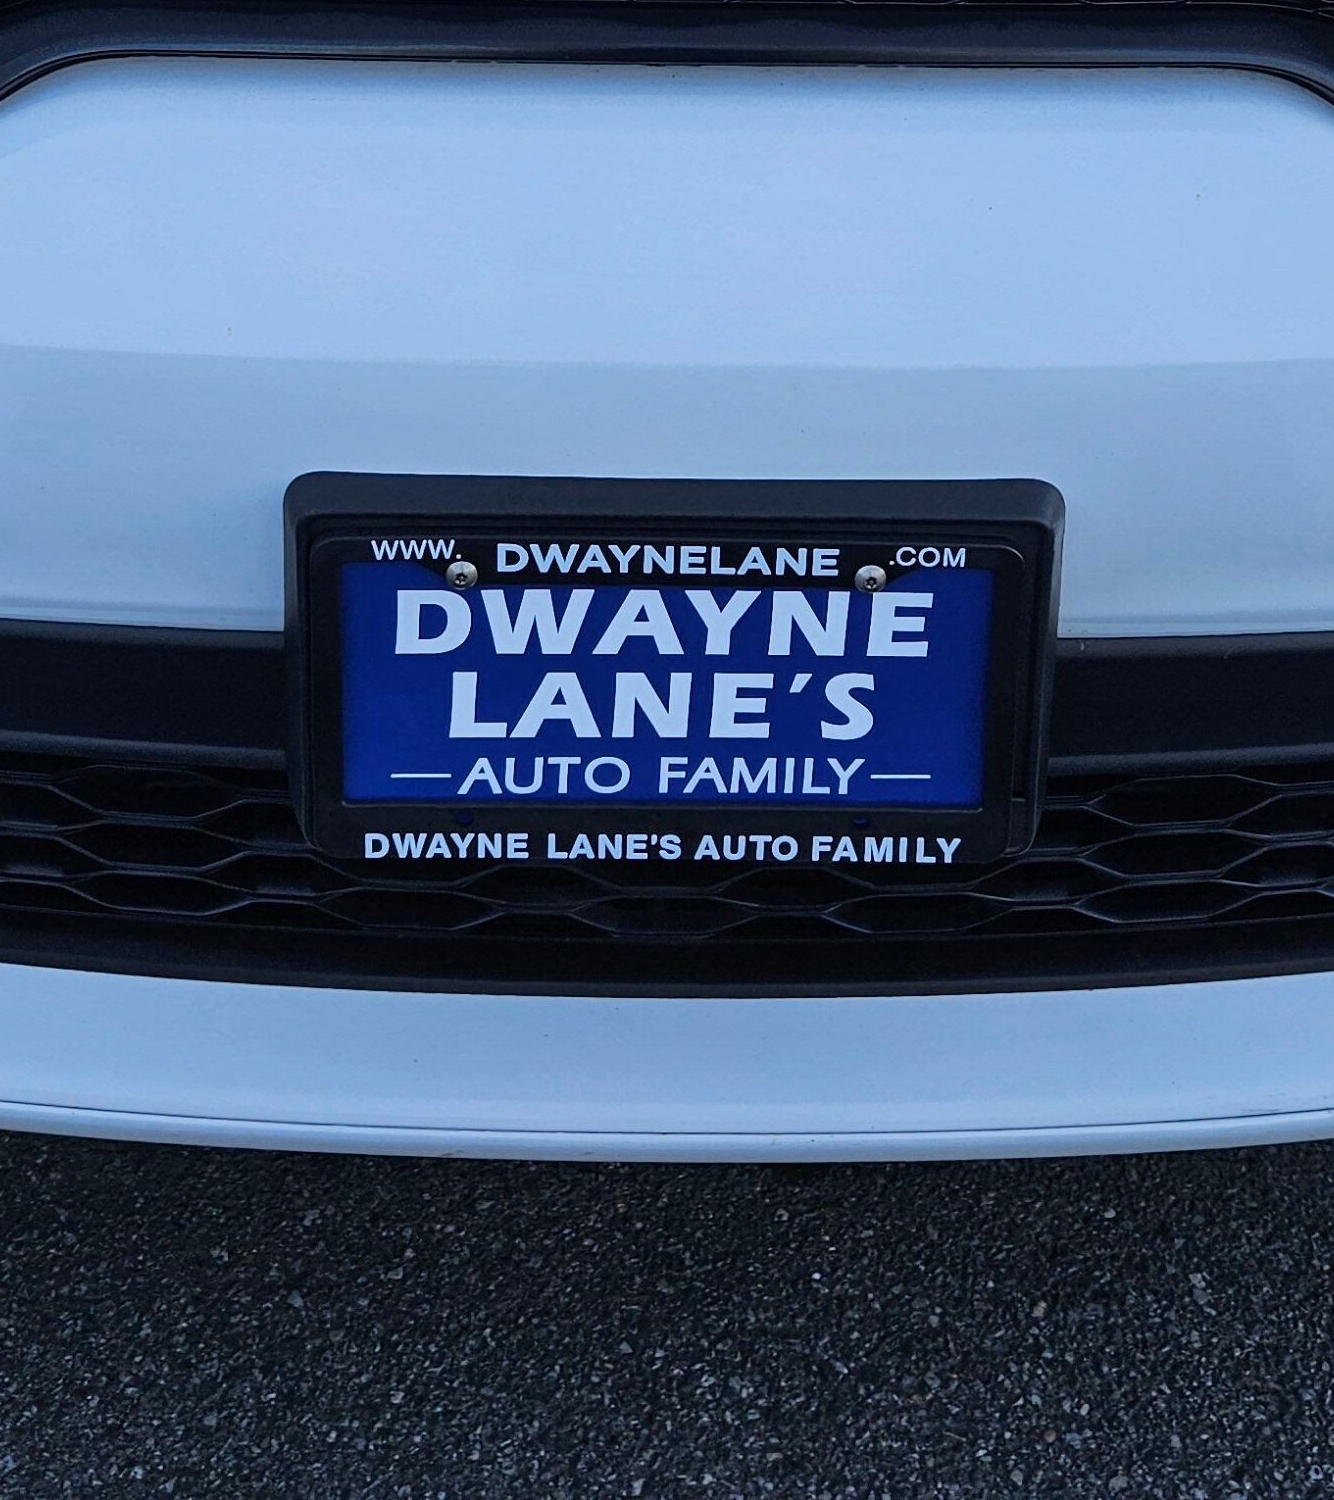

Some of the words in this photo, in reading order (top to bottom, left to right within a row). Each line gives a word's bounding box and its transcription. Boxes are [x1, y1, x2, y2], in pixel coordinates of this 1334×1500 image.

[371, 538, 462, 560] WWW.
[496, 542, 841, 577] DWAYNELANE
[888, 546, 967, 568] .COM
[394, 588, 935, 658] DWAYNE
[448, 670, 875, 741] LANE'S
[456, 756, 631, 795] AUTO
[658, 756, 866, 795] FAMILY
[364, 832, 530, 860] DWAYNE
[547, 832, 682, 860] LANE'S
[693, 834, 799, 862] AUTO
[811, 835, 962, 864] FAMILY
